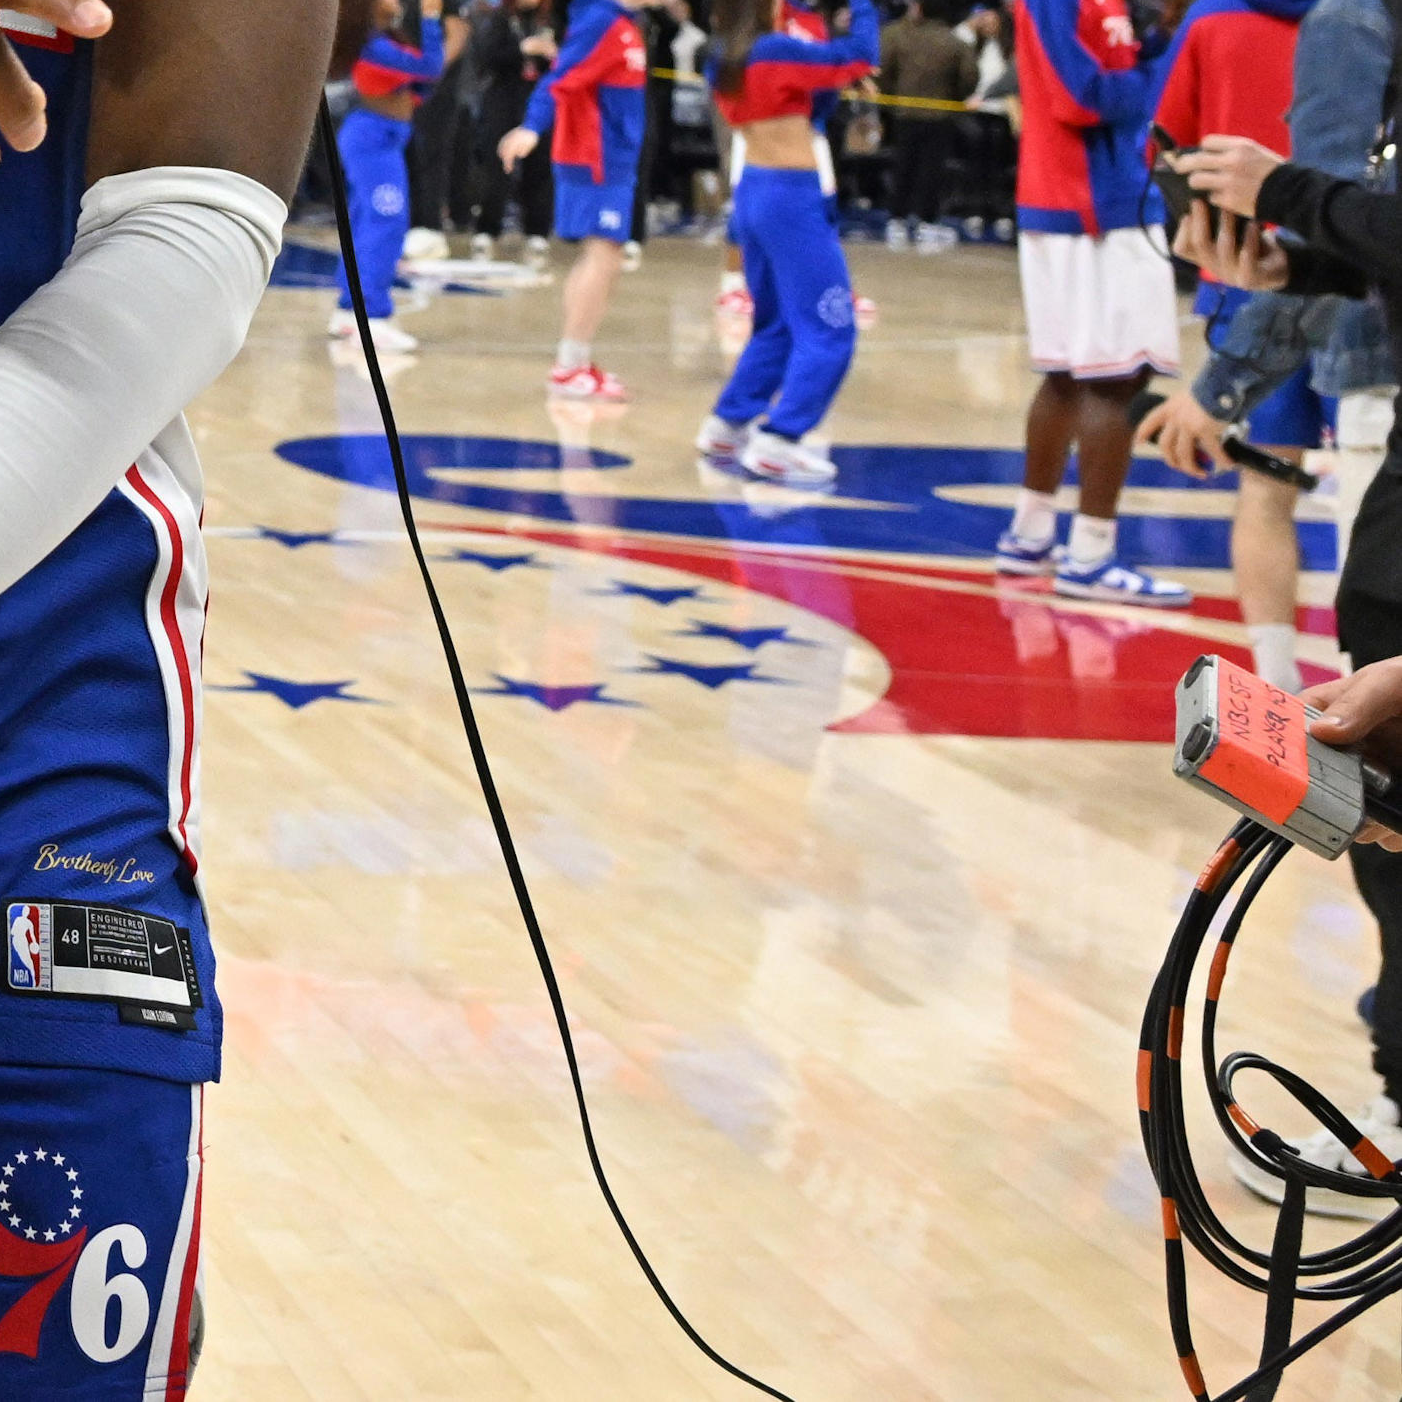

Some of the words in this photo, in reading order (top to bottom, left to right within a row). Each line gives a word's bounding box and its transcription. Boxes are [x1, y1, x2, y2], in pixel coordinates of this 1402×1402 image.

[34, 843, 118, 883] Brotherly
[116, 857, 155, 883] Love
[90, 913, 144, 929] ENGINEERED
[61, 929, 80, 945] 48
[13, 969, 30, 984] NBA
